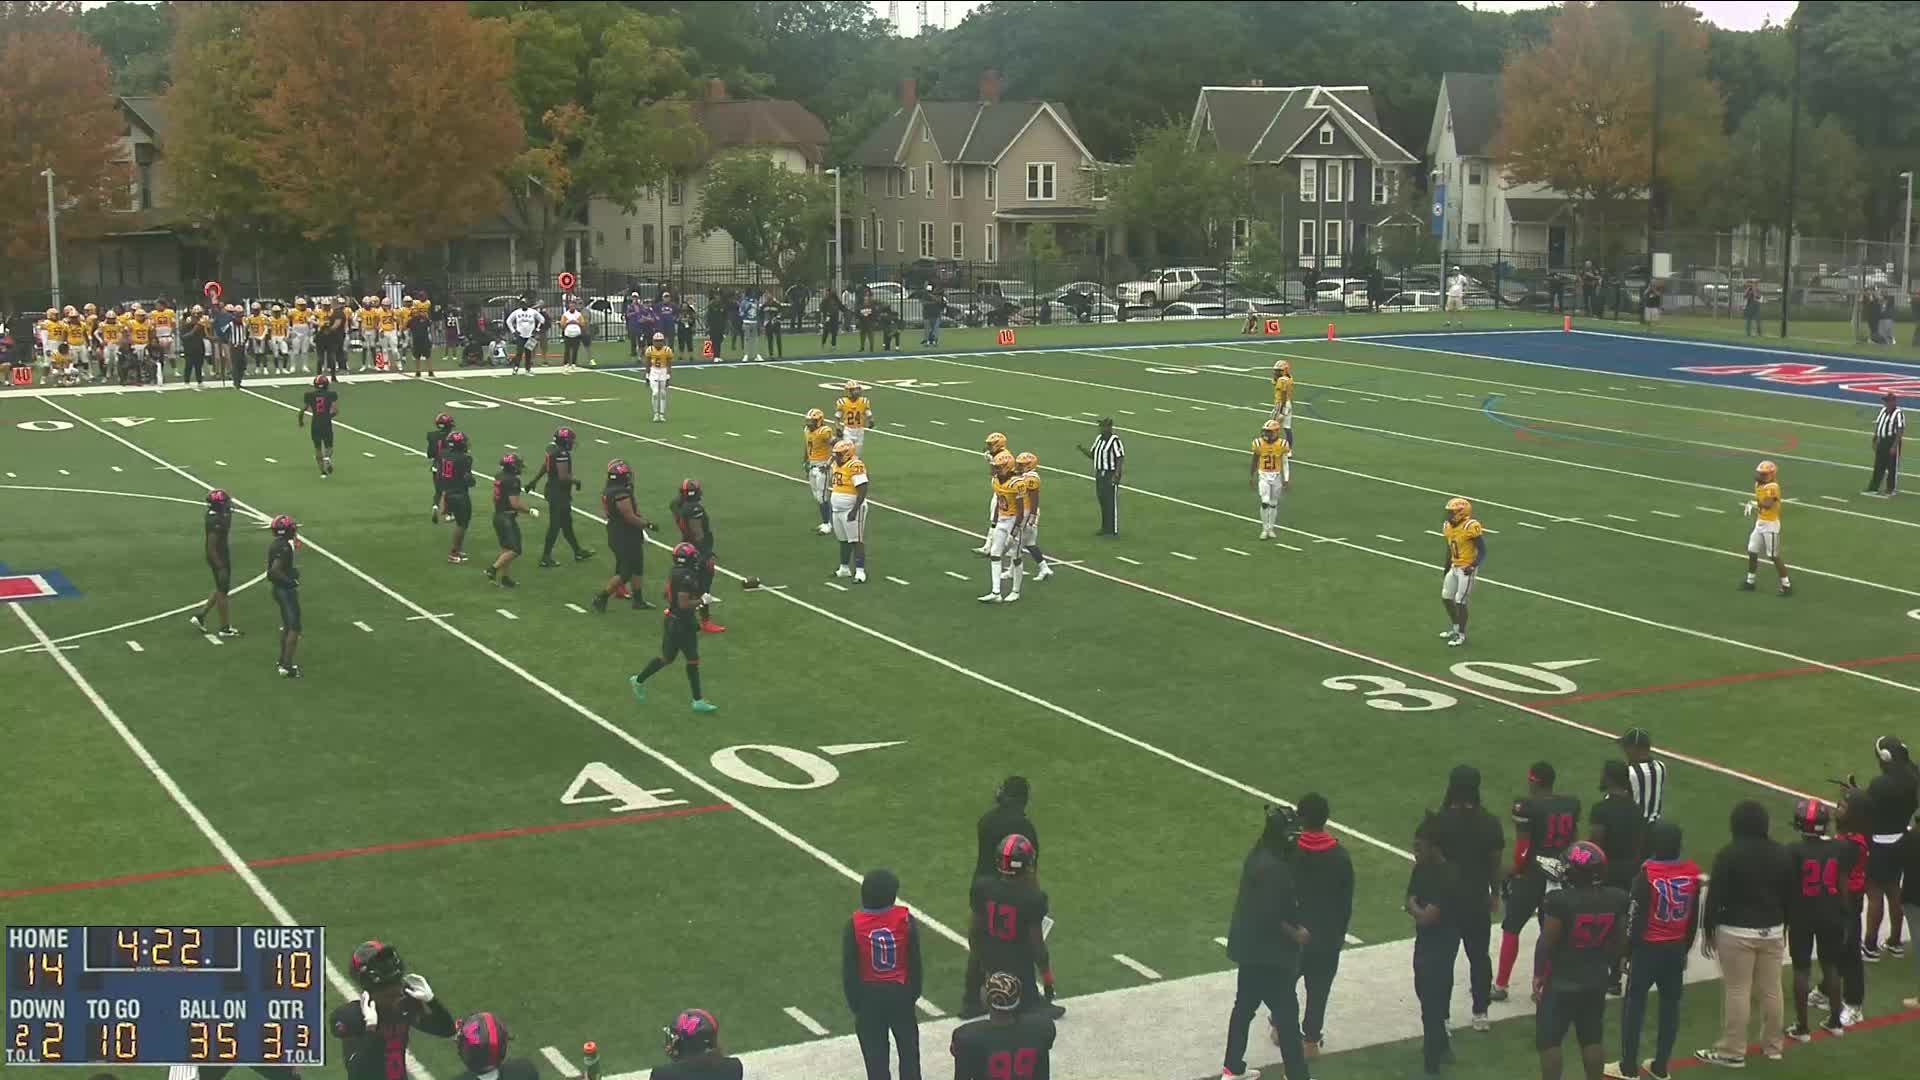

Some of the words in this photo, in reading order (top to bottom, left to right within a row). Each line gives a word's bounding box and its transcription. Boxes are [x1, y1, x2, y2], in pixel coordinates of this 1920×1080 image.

[1001, 330, 1013, 342] 10
[1269, 320, 1279, 332] G
[15, 369, 31, 383] 40
[847, 411, 861, 425] 24
[1263, 454, 1276, 470] 21
[1802, 858, 1840, 897] 24
[1653, 875, 1692, 922] 15
[986, 901, 1018, 941] 13
[1567, 912, 1616, 949] 57
[868, 926, 897, 972] 0
